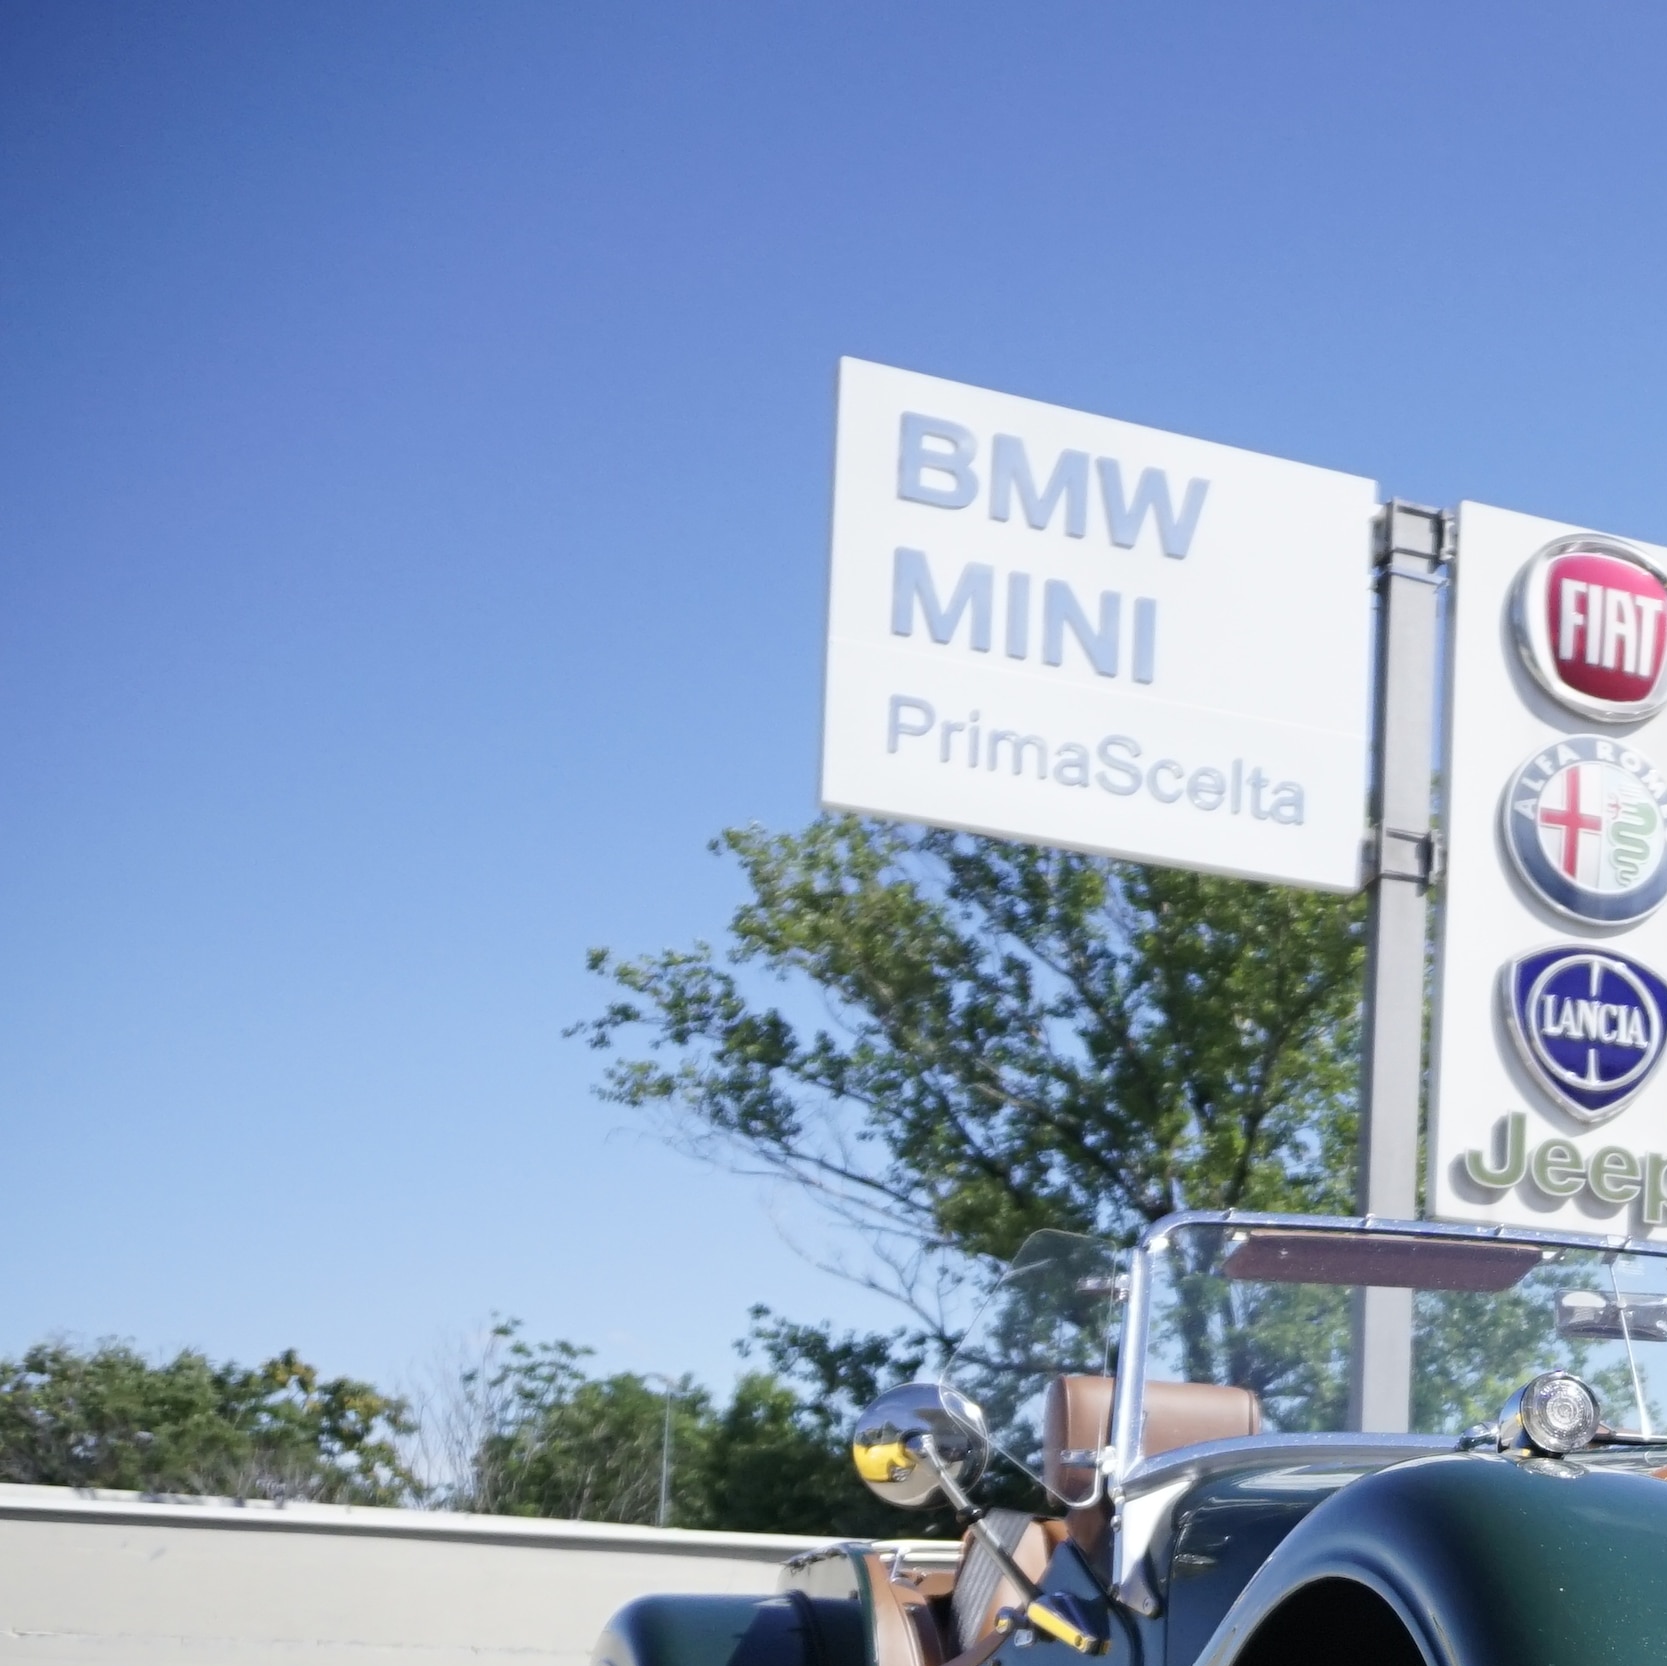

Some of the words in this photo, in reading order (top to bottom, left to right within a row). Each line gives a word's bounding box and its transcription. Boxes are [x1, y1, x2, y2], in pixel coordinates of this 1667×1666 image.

[897, 410, 1211, 561] BMW
[891, 546, 1157, 685] MINI
[1559, 577, 1664, 678] FIAT
[887, 693, 1306, 827] PrimaScelta
[1513, 743, 1582, 821] ALFA
[1542, 994, 1649, 1049] LANCIA
